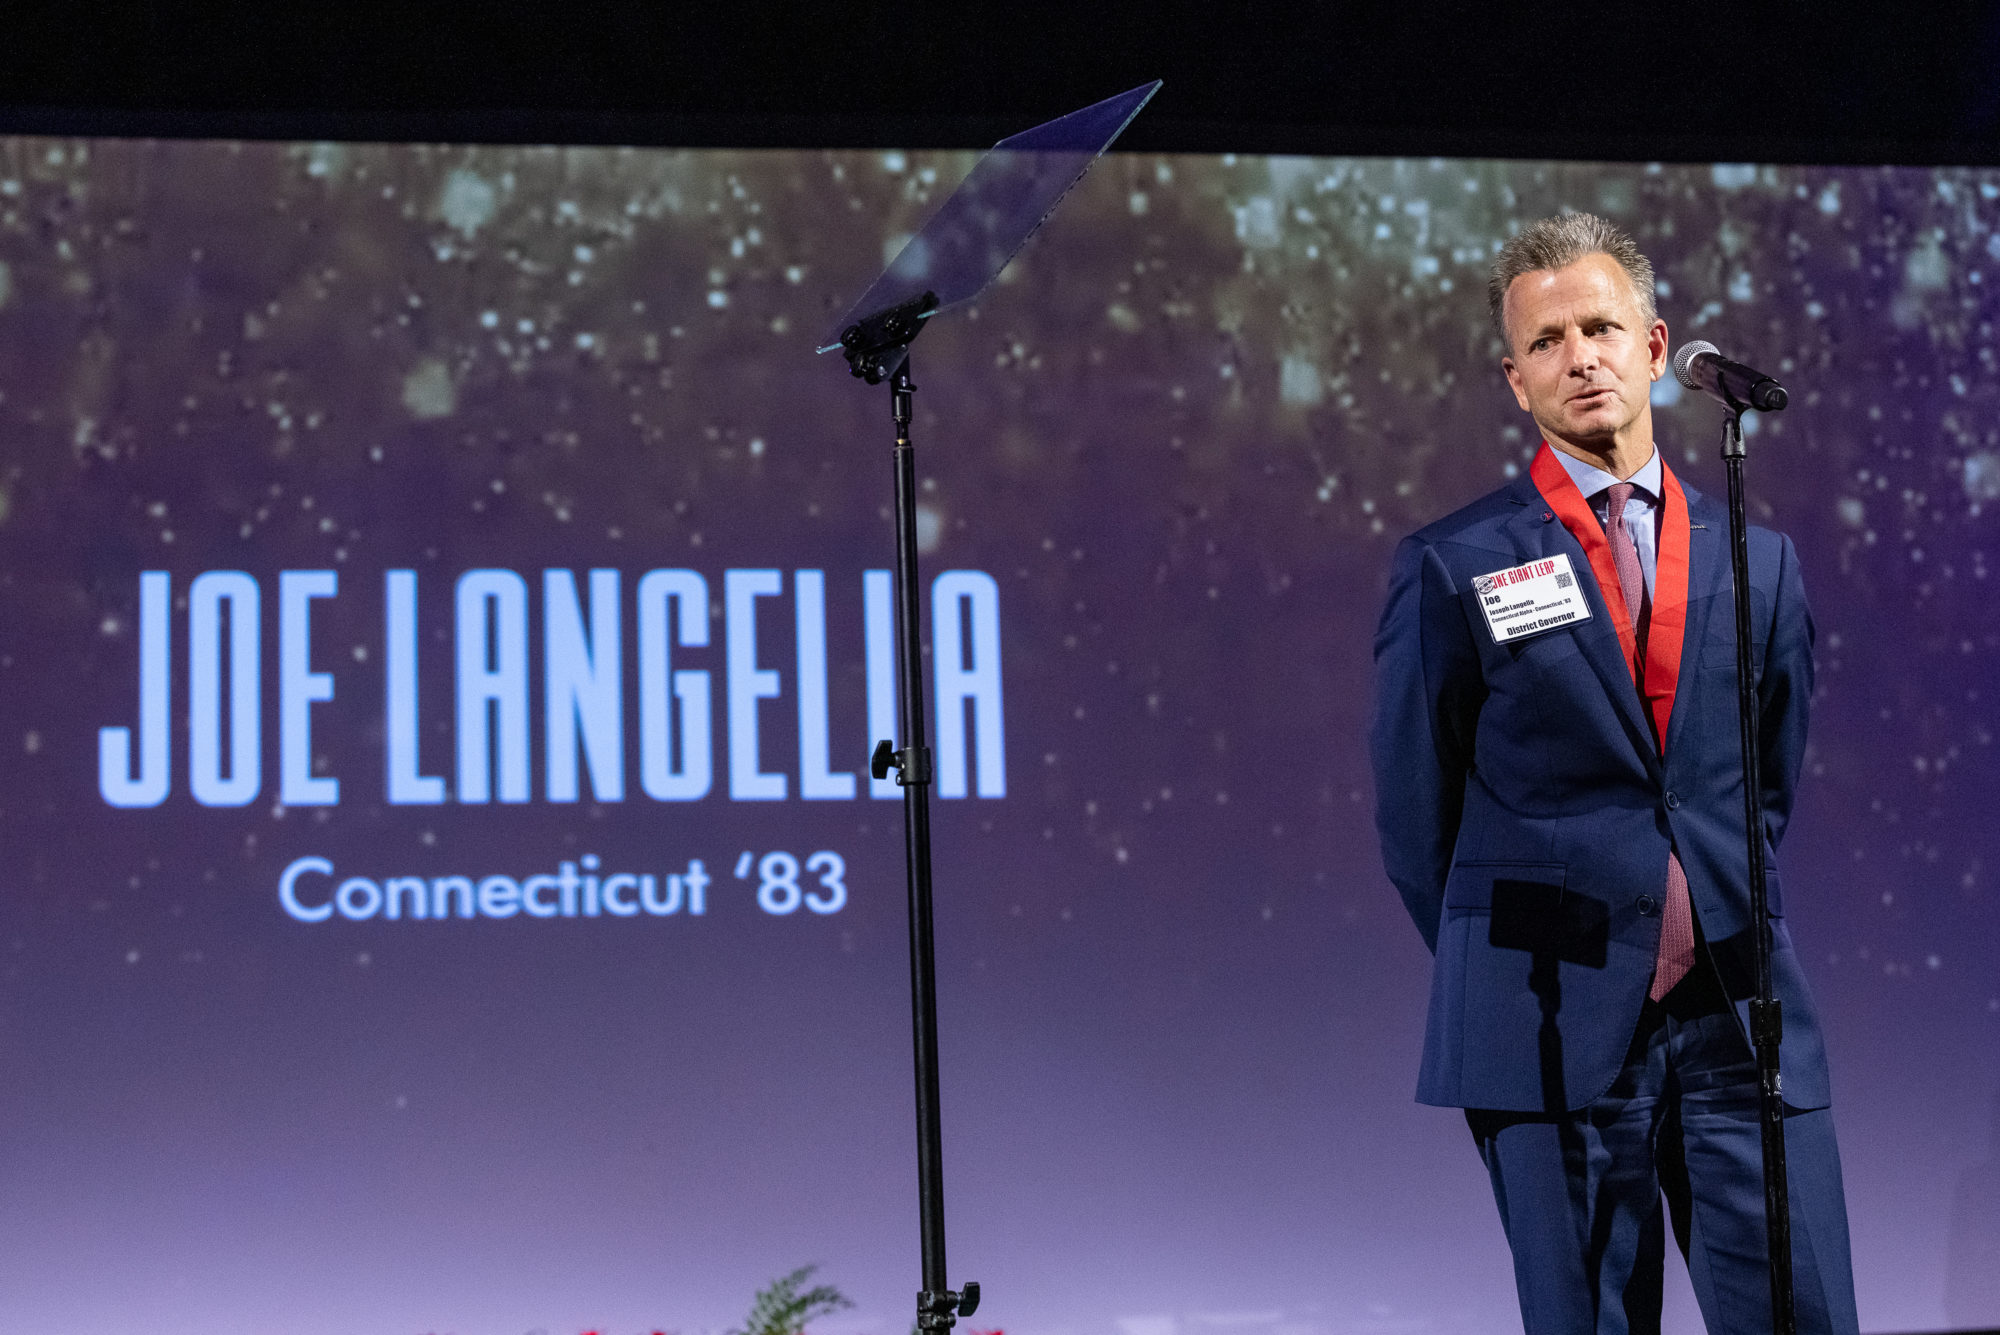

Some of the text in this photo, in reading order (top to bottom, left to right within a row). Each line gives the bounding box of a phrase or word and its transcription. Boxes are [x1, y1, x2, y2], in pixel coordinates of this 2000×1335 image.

[1508, 565, 1534, 585] GIANT
[1535, 560, 1555, 577] LEAP
[1484, 595, 1501, 606] Joe
[1489, 599, 1535, 616] Joseph Langella
[1491, 611, 1520, 623] Connecticut
[1507, 612, 1575, 635] District Governor
[97, 568, 1008, 809] JOE LANGELLA
[277, 851, 848, 923] Connecticut '83
